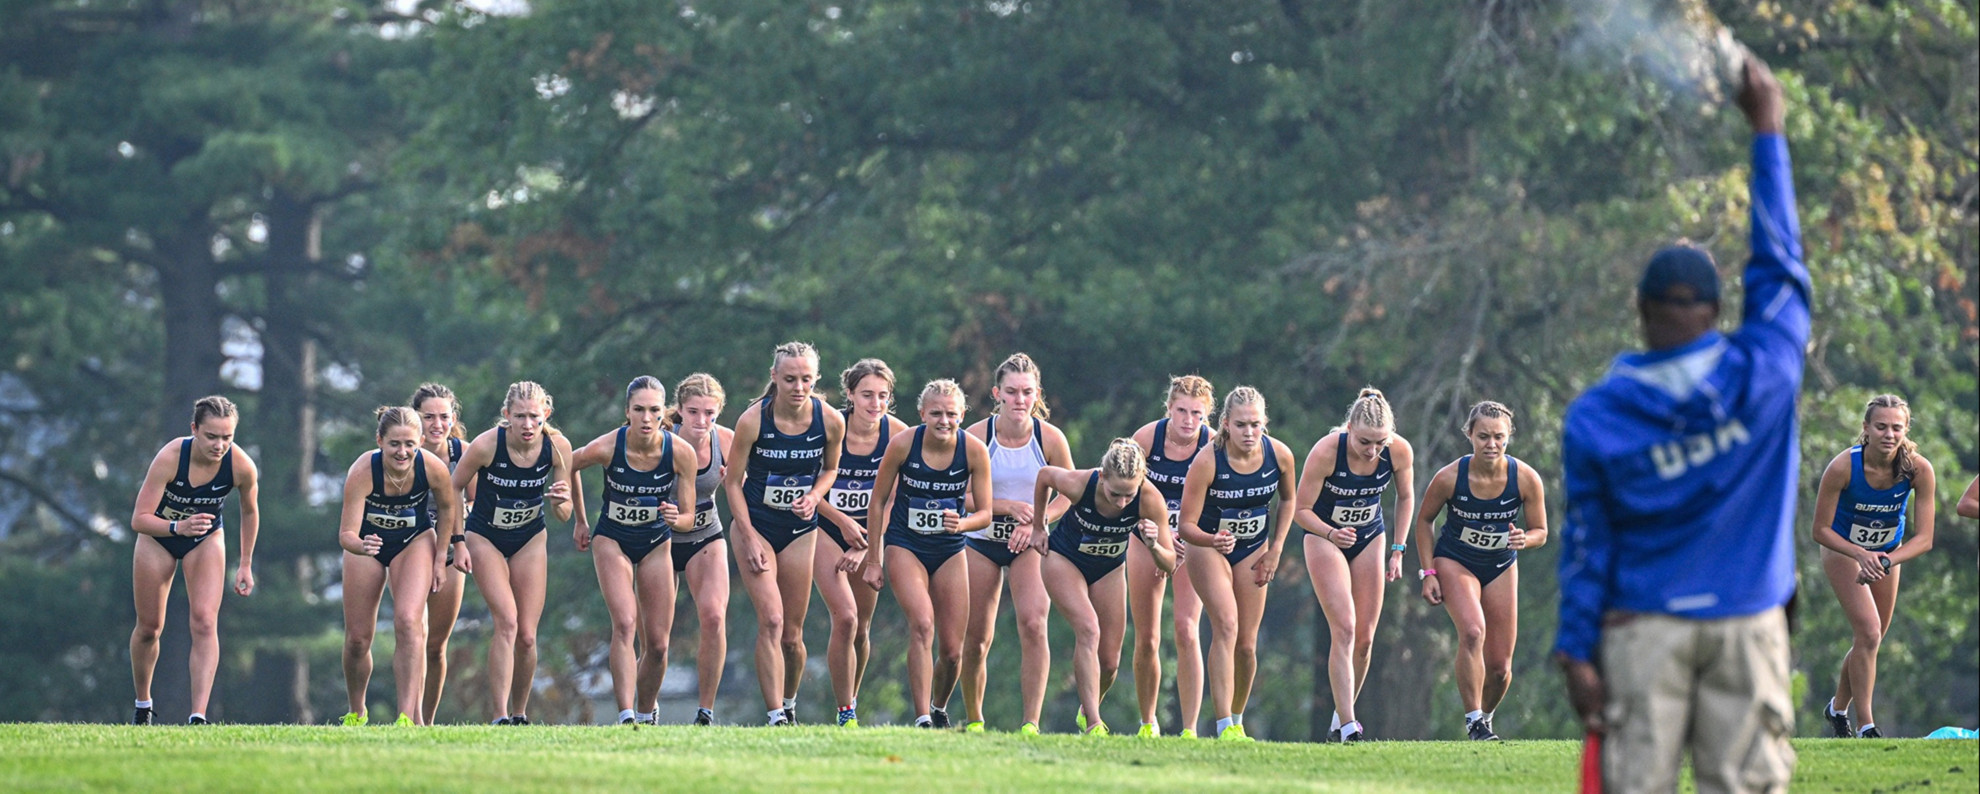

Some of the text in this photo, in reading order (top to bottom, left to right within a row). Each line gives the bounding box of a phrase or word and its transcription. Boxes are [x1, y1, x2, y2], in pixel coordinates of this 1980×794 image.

[756, 446, 788, 459] PENN
[487, 472, 518, 487] PENN
[1209, 488, 1244, 499] PENN
[1324, 480, 1358, 496] PENN
[836, 492, 869, 508] 360
[501, 508, 534, 525] 352
[615, 507, 650, 521] 348
[1339, 508, 1371, 523] 356
[374, 517, 408, 528] 359
[1227, 519, 1259, 534] 353
[1467, 531, 1502, 548] 357
[1857, 528, 1890, 544] 347
[1086, 544, 1120, 555] 350
